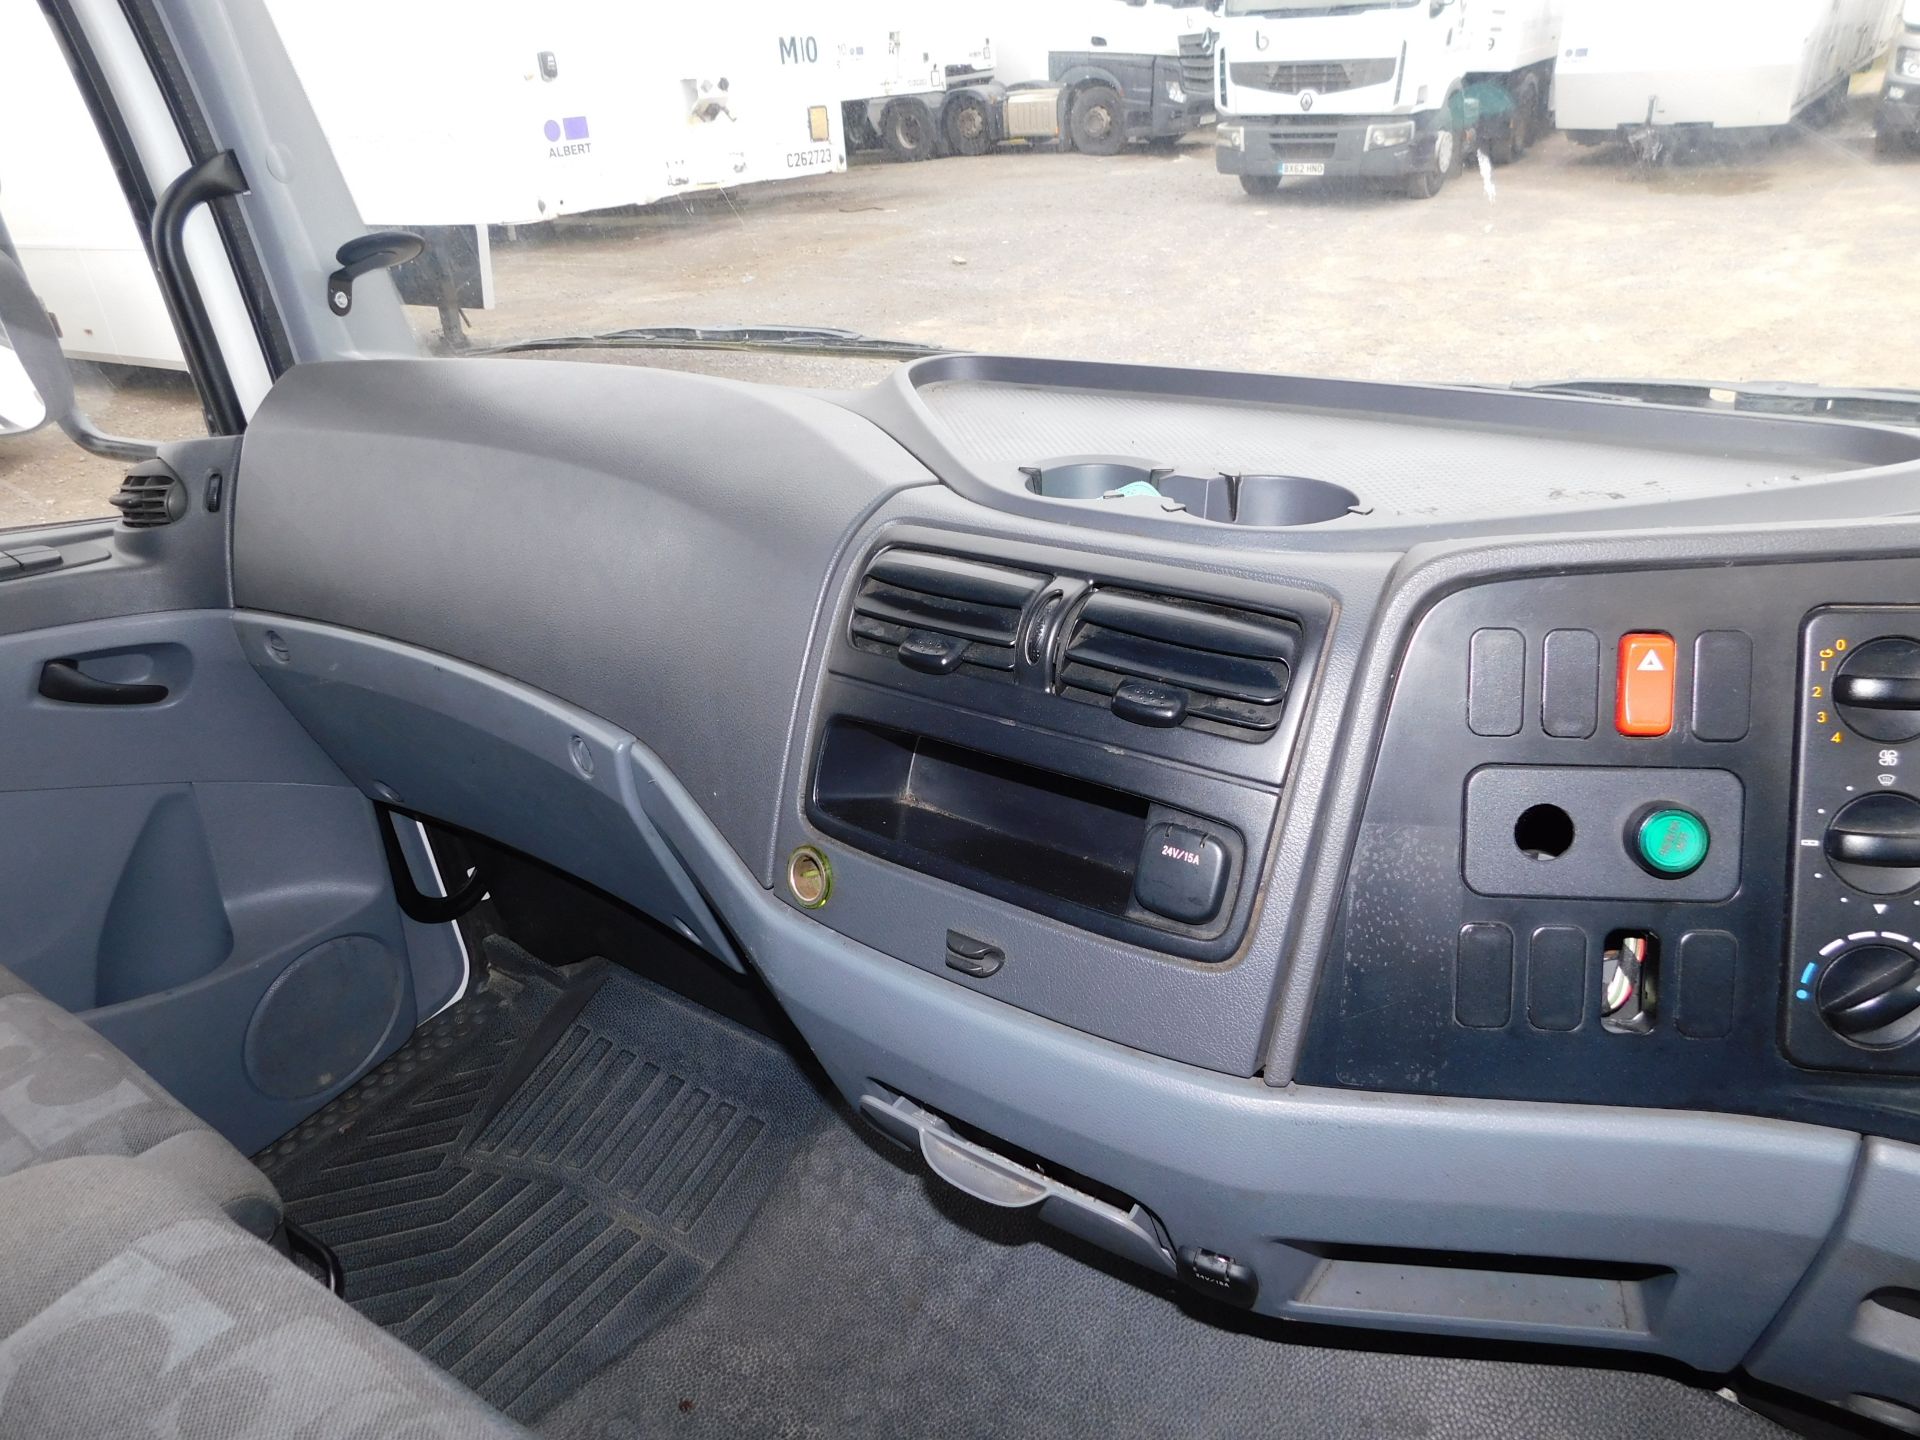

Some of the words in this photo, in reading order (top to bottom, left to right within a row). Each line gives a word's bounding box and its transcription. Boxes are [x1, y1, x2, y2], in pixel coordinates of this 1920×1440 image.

[549, 142, 591, 158] ALBERT
[787, 149, 832, 168] C262723
[1836, 639, 1846, 651] 0
[1820, 660, 1826, 672] 1
[1812, 686, 1822, 698] 2
[1816, 711, 1827, 723] 3
[1830, 732, 1842, 743] 4
[1161, 845, 1200, 866] 24V/15A
